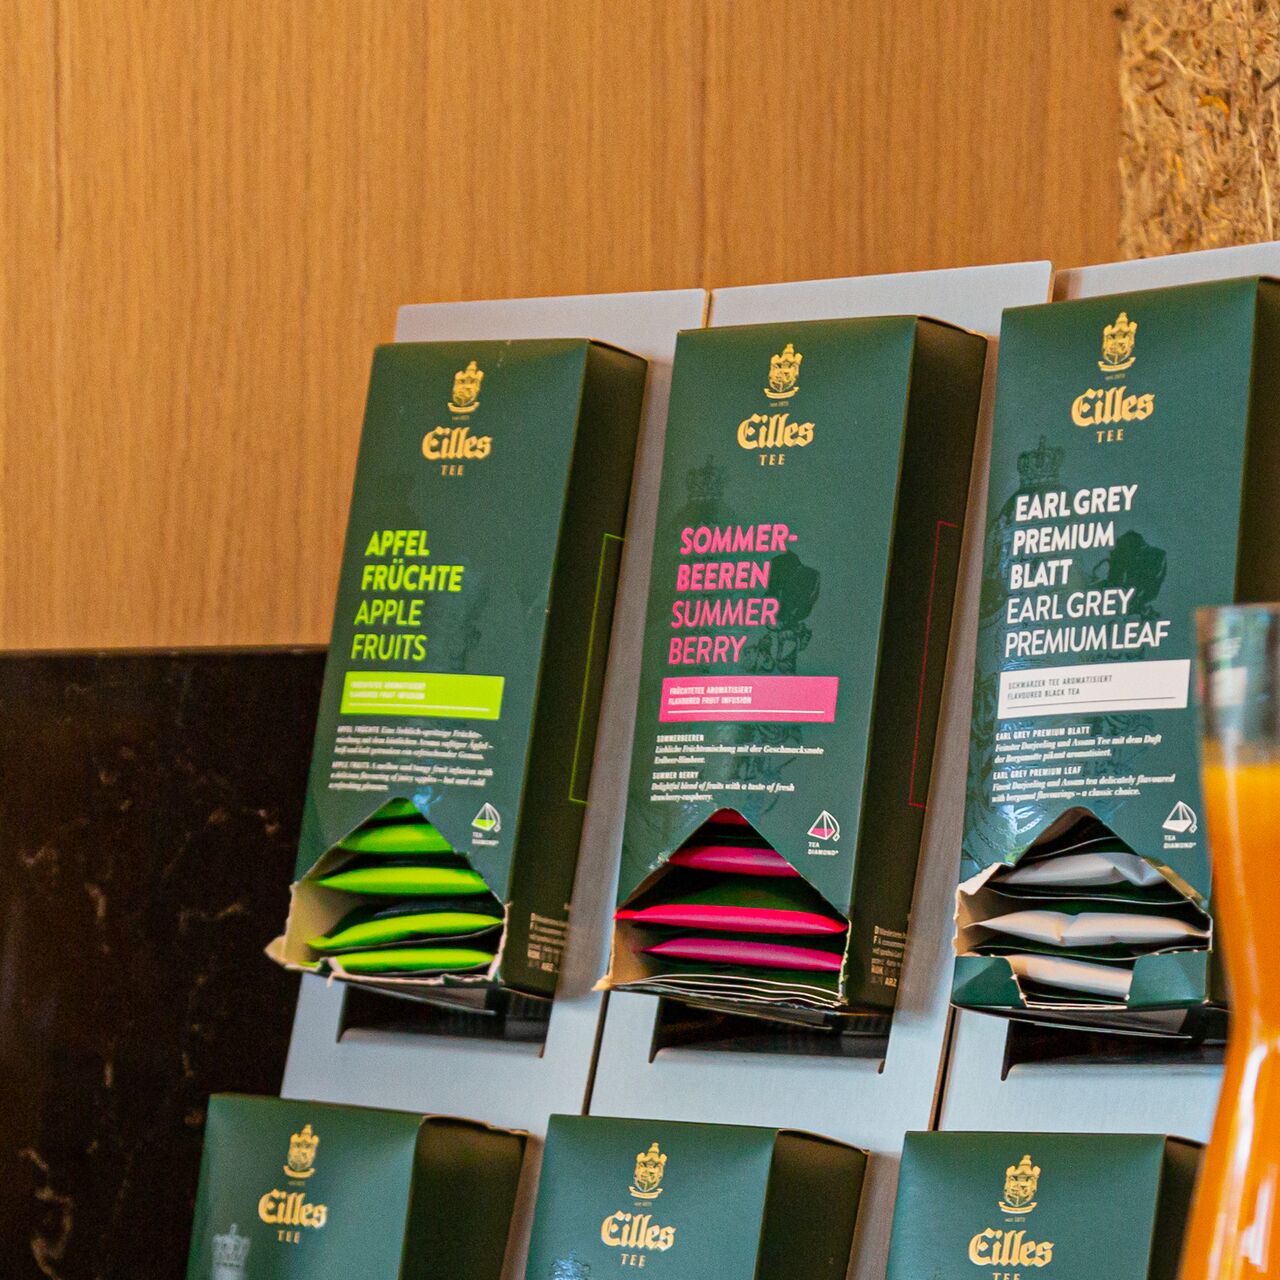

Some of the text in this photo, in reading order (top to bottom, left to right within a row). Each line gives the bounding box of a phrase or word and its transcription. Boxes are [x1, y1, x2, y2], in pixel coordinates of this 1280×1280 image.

[1071, 386, 1155, 427] Eilles
[422, 426, 493, 460] Eilles
[737, 412, 815, 450] Eilles
[1096, 429, 1124, 443] TEE
[441, 464, 464, 476] TEE
[759, 454, 785, 466] TEE
[1014, 484, 1138, 522] EARL GREY
[365, 530, 430, 556] APFEL
[680, 524, 798, 555] SOMMER-
[1012, 521, 1115, 556] PREMIUM
[361, 559, 464, 592] FRÜCHTE
[676, 561, 770, 592] BEEREN
[1010, 559, 1073, 590] BLATT
[353, 599, 424, 626] APPLE
[671, 598, 780, 629] SUMMER
[1006, 587, 1135, 624] EARL GREY
[351, 634, 428, 661] FRUITS
[668, 635, 747, 665] BERRY
[1004, 620, 1171, 658] PREMIUM LEAF
[1007, 690, 1042, 700] FLAVOURED
[1045, 689, 1065, 697] BLACK
[1063, 675, 1112, 685] AROMATISIERT
[995, 726, 1090, 741] EARL GREY PREMIUM BLATT
[679, 771, 699, 779] BERRY
[993, 766, 1081, 780] EARL GREY PREMIUM LEAF
[258, 1188, 328, 1229] Eilles
[277, 1230, 301, 1244] TEE
[601, 1210, 677, 1251] Eilles
[621, 1253, 646, 1269] TEE
[968, 1227, 1055, 1268] Eilles
